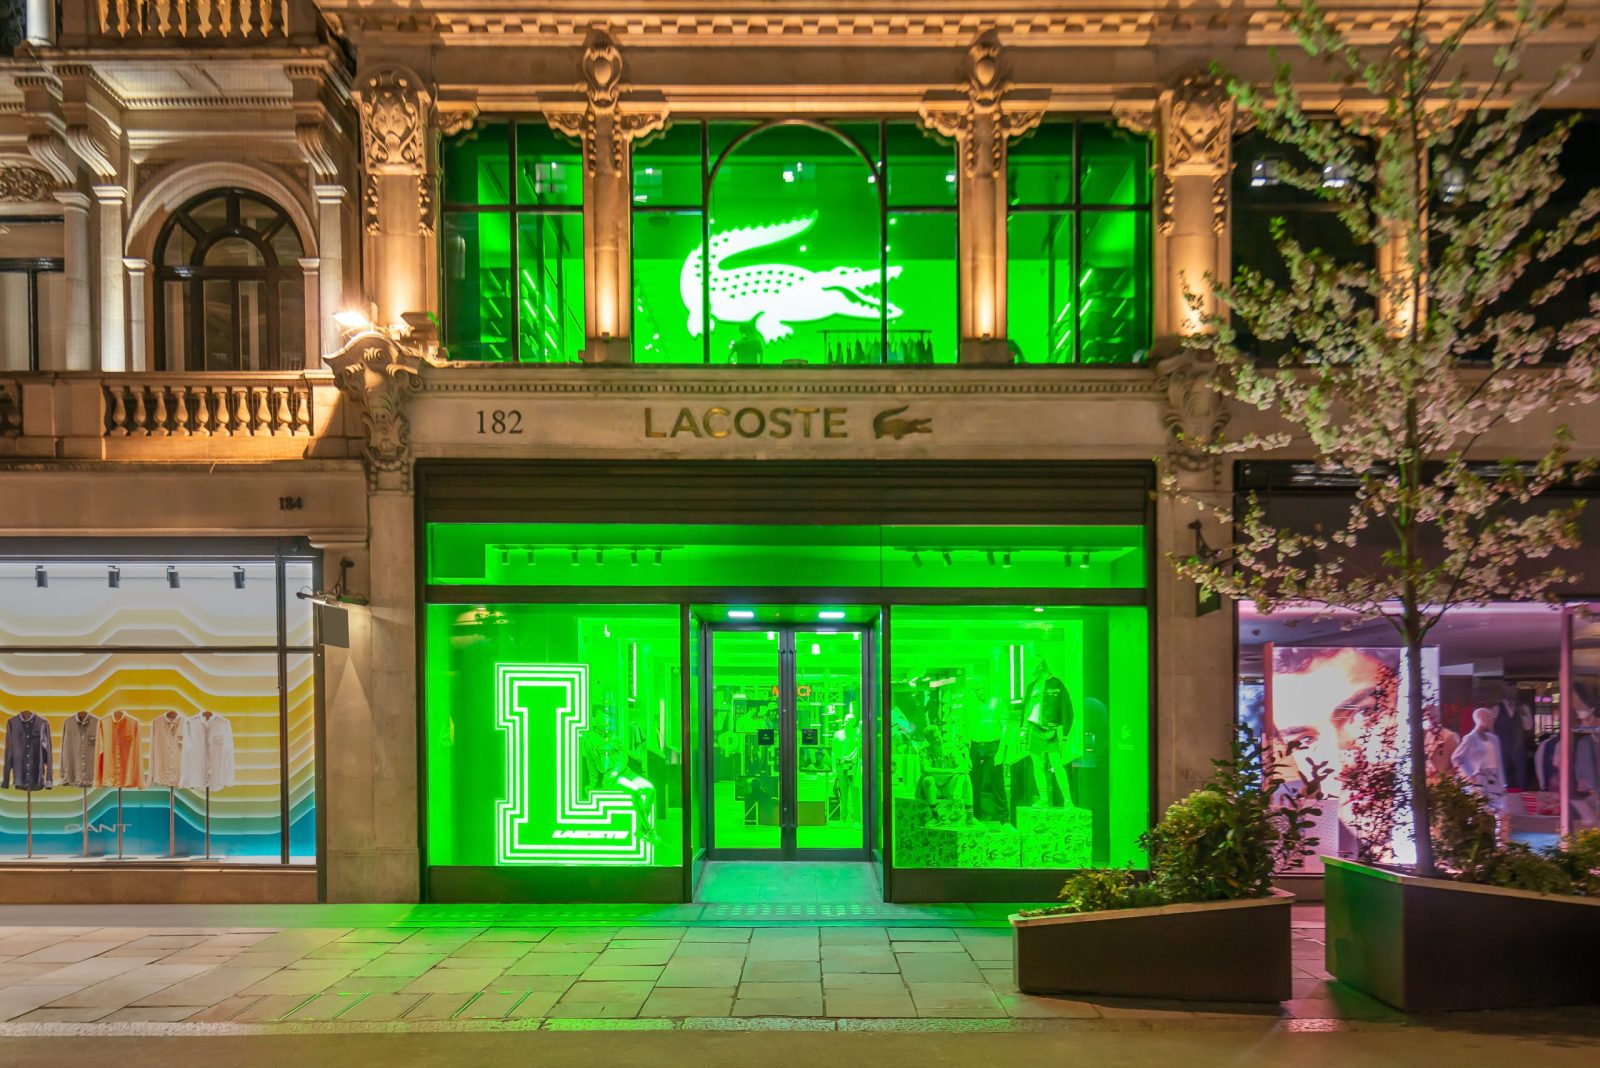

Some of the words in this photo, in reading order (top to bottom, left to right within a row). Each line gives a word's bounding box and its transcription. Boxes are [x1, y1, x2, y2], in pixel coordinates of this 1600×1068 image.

[476, 409, 524, 435] 182
[644, 406, 849, 439] LACOSTE
[278, 496, 304, 511] 184
[495, 663, 654, 866] L
[552, 830, 629, 840] LAOTE
